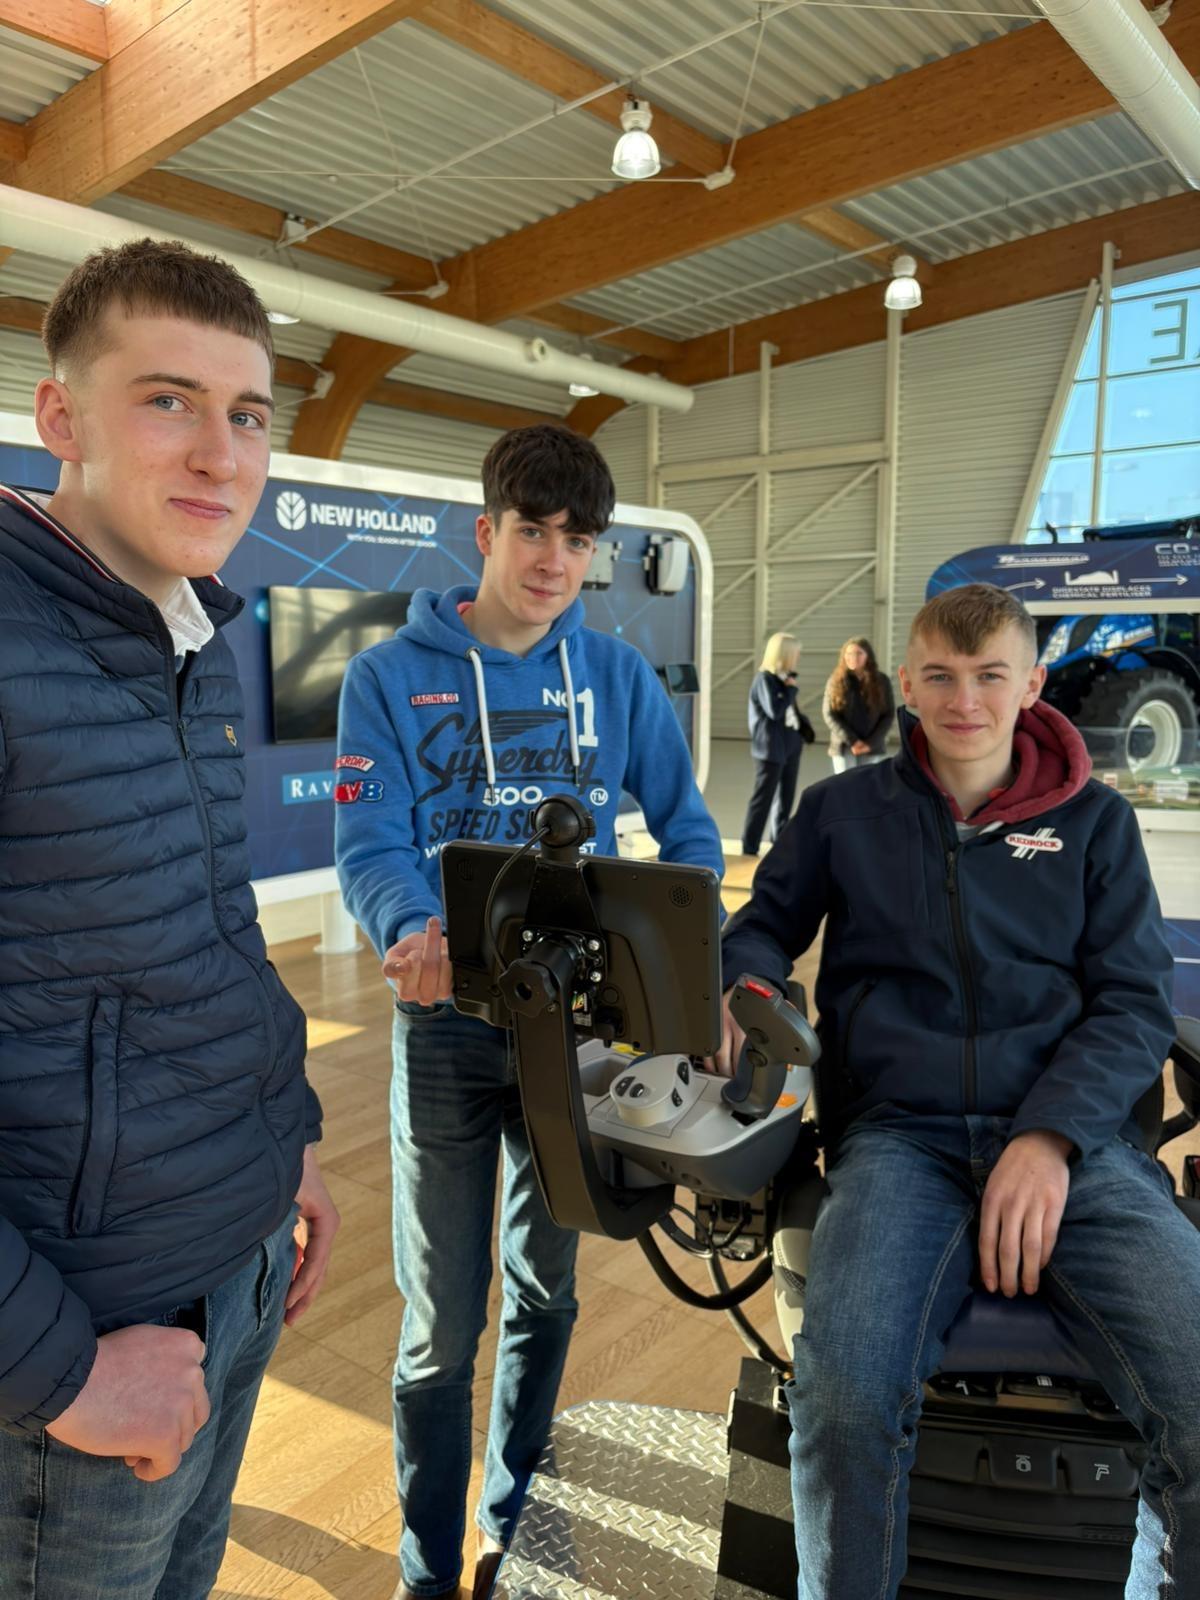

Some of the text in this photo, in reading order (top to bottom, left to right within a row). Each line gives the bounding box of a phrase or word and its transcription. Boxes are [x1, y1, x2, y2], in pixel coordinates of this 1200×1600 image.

[310, 502, 437, 535] NEW HOLLAND
[576, 687, 599, 747] 1
[415, 711, 604, 804] Superdry
[291, 778, 333, 799] RAV
[428, 808, 500, 842] SPEED
[1008, 835, 1058, 849] REDROCK
